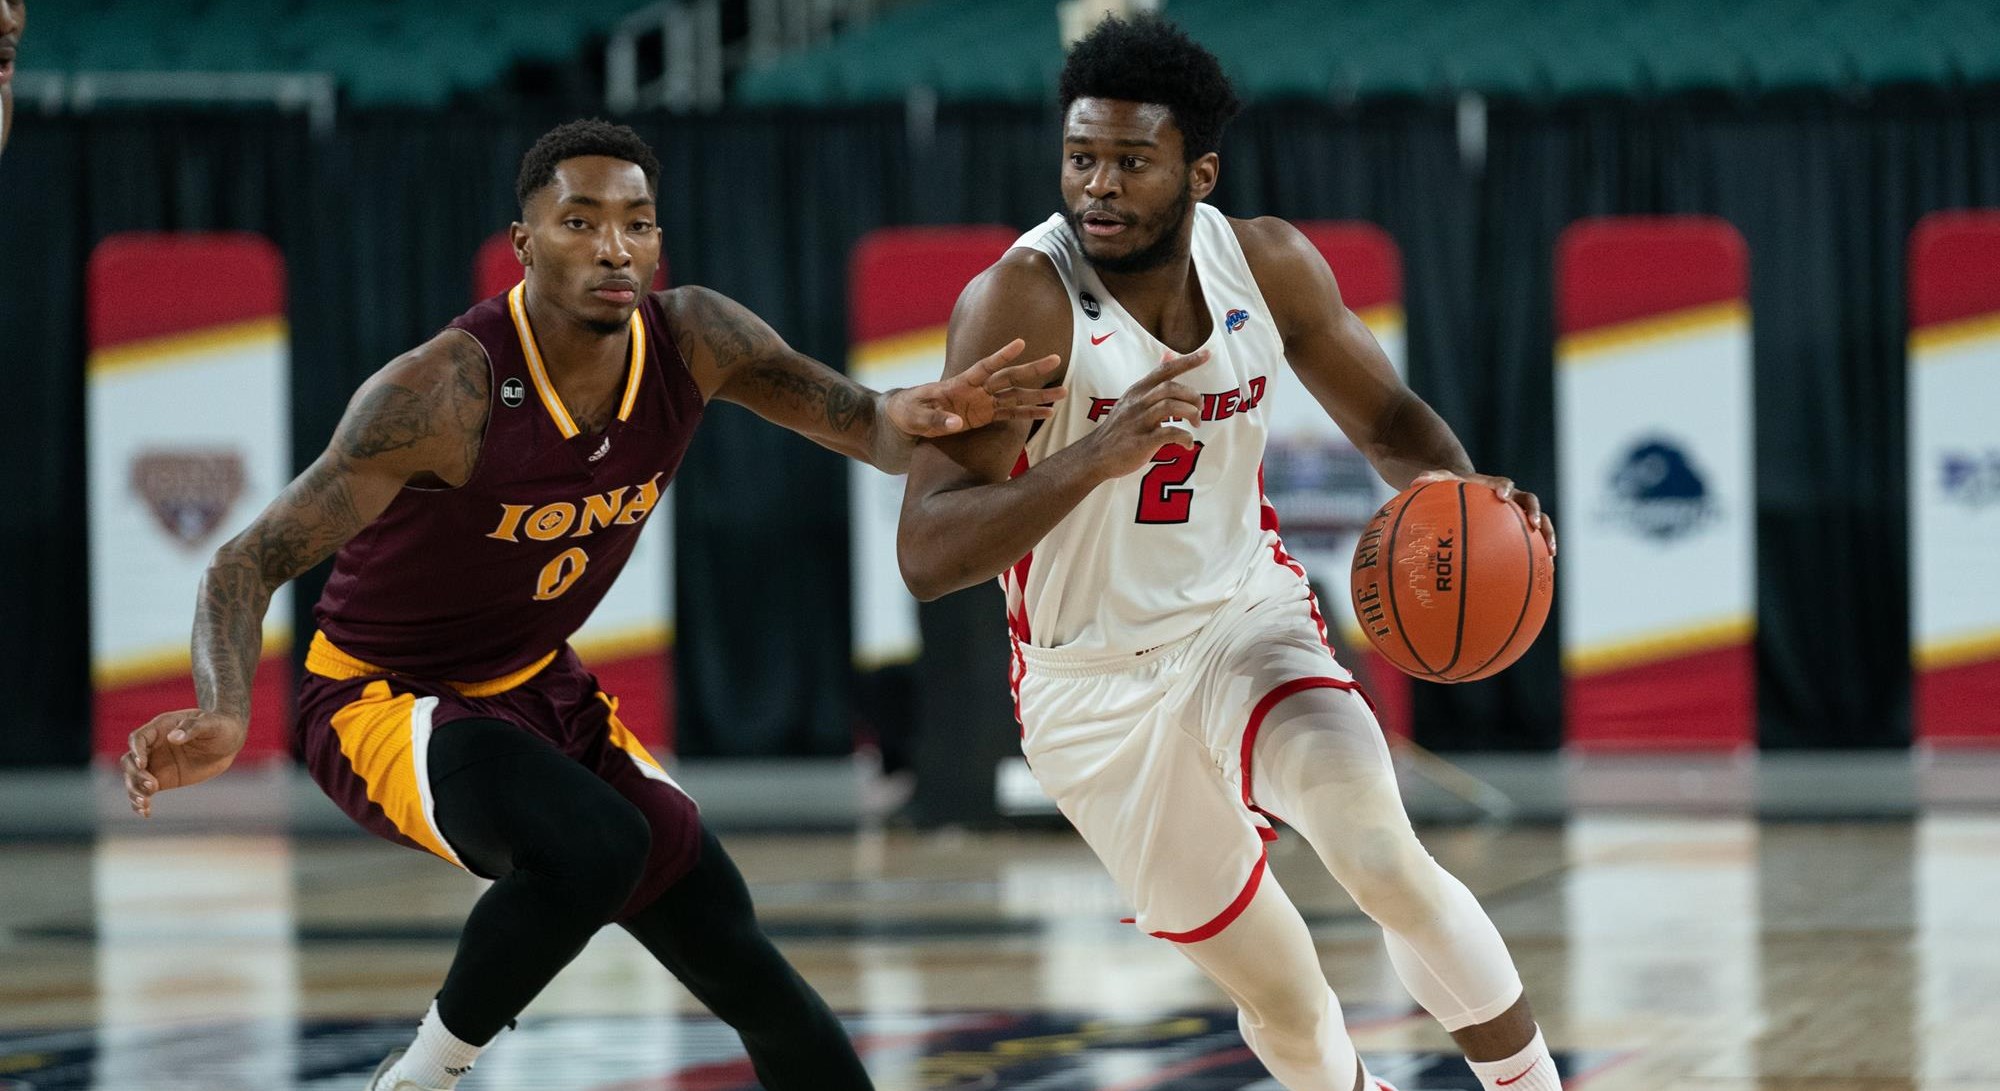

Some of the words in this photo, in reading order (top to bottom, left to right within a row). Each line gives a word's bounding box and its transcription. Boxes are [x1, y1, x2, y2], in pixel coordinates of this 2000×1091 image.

[503, 386, 523, 398] BLM
[1087, 376, 1266, 423] FIELD
[485, 471, 664, 543] IONA
[1135, 441, 1205, 525] 2
[1355, 505, 1395, 571] ROCK
[1428, 553, 1436, 570] THE
[532, 547, 589, 601] 0
[1357, 581, 1391, 643] THE
